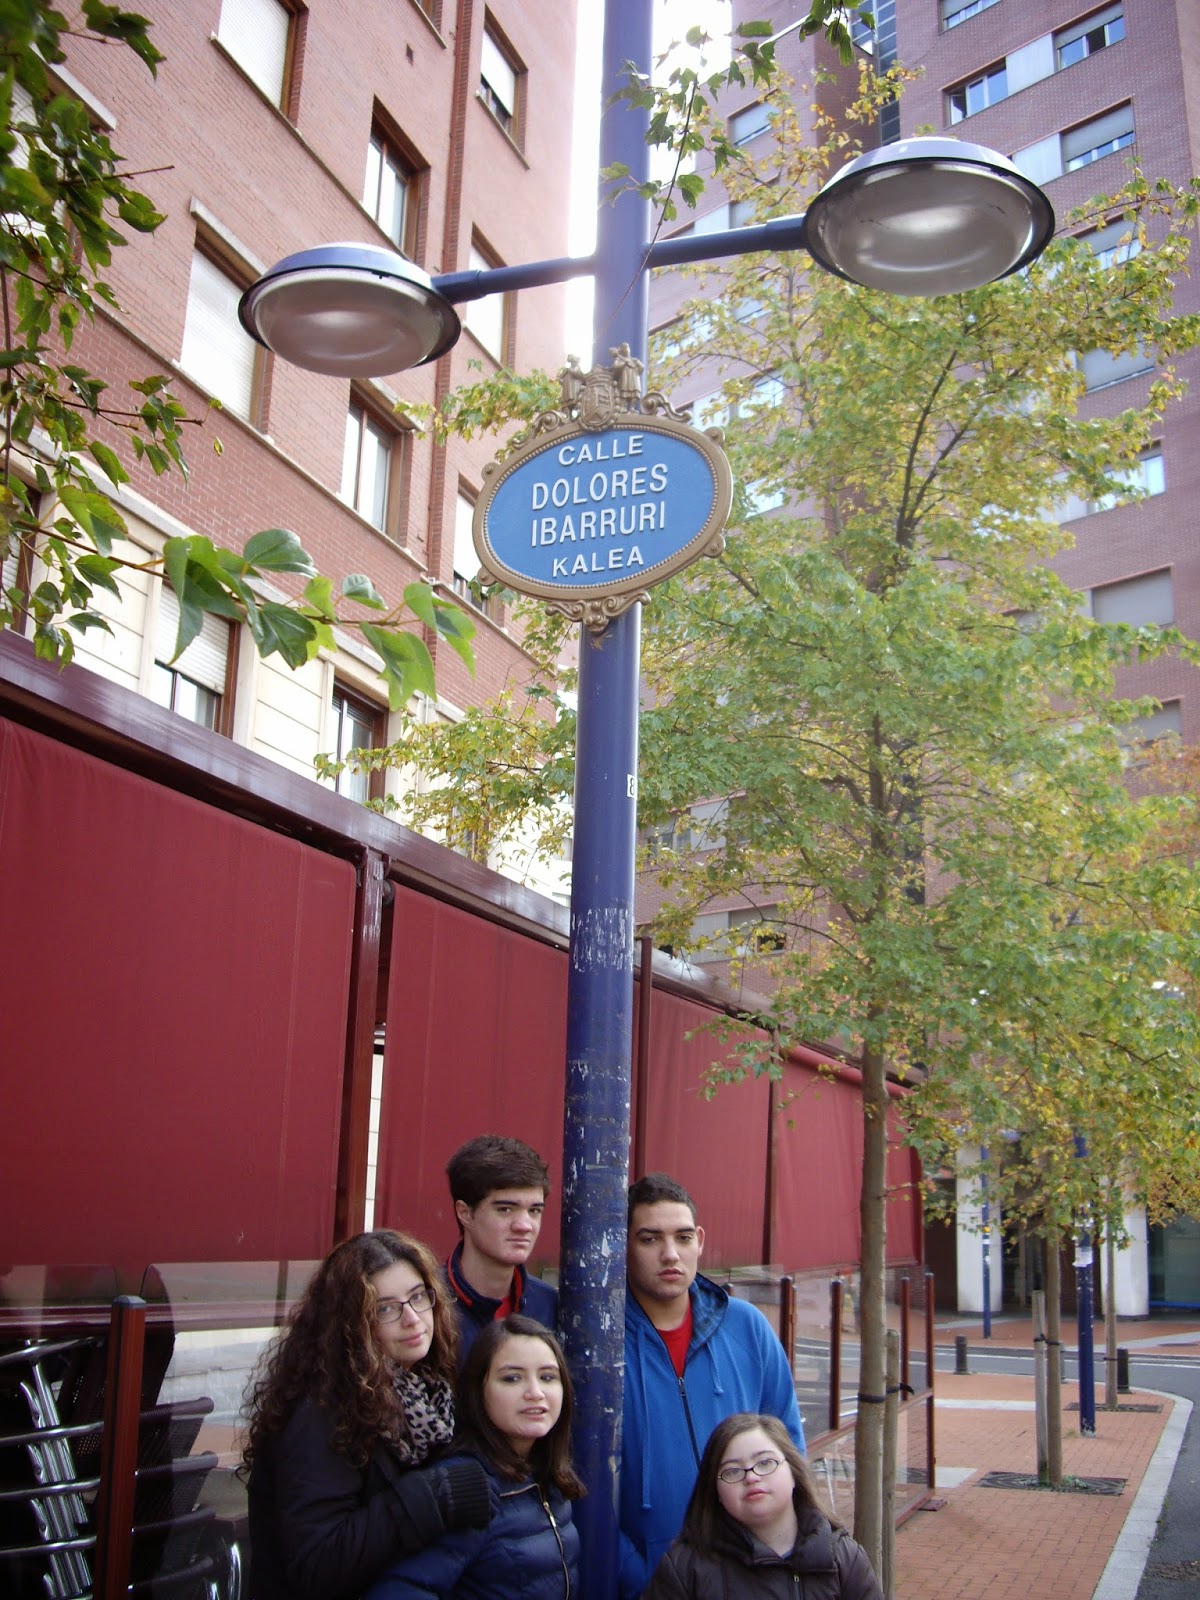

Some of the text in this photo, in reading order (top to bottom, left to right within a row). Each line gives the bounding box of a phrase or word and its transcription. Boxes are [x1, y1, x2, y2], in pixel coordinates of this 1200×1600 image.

[558, 435, 644, 466] CALLE
[532, 463, 668, 510] DOLORES
[531, 501, 665, 547] IBARRURI
[552, 546, 644, 577] KALEA
